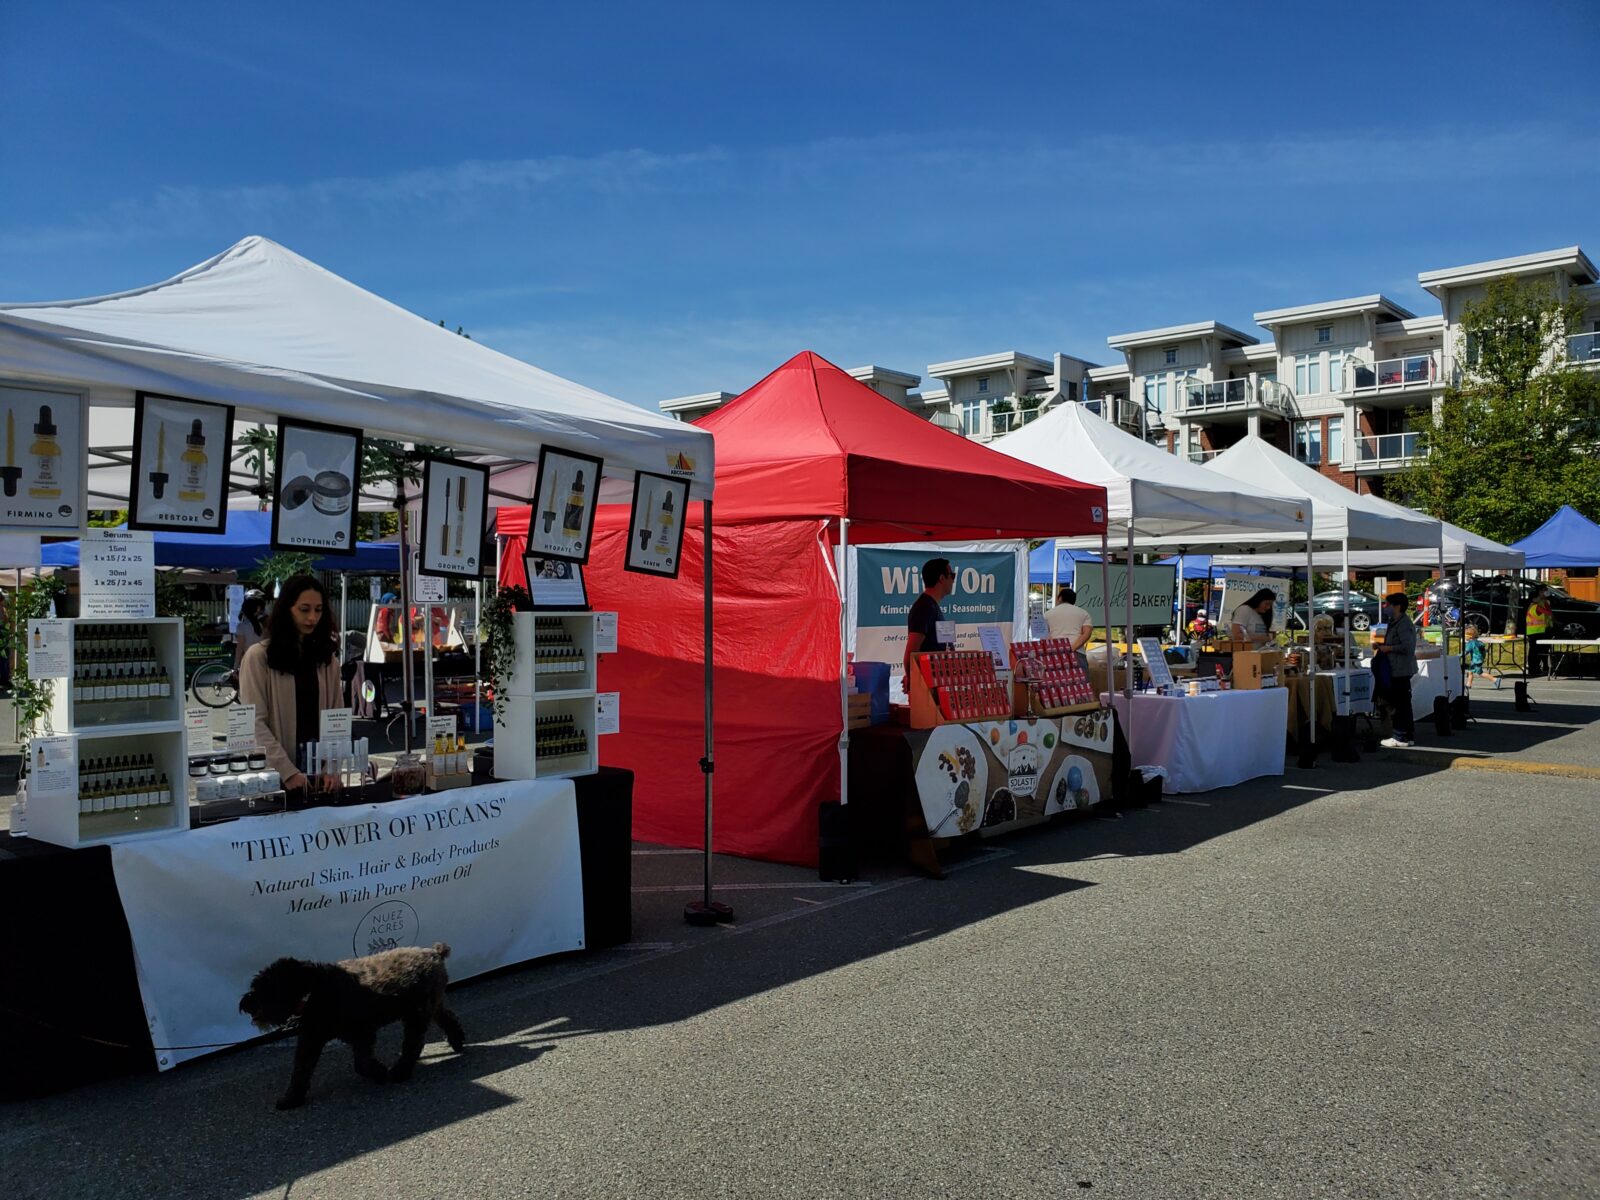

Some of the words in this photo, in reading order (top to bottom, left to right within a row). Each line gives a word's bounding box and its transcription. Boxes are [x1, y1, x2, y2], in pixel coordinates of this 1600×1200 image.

[7, 510, 53, 519] FIRMING
[158, 513, 200, 522] RESTORE
[103, 530, 133, 538] Serums
[290, 536, 338, 546] SOFTENING
[438, 562, 465, 571] GROWTH
[1132, 592, 1172, 608] BAKERY
[952, 603, 996, 614] Seasonings
[231, 836, 295, 862] "THE
[300, 821, 382, 854] POWER
[389, 814, 417, 838] OF
[423, 797, 507, 832] PECANS"
[250, 872, 316, 897] Natural
[319, 866, 354, 886] Skin,
[359, 856, 391, 877] Hair
[395, 854, 406, 870] &
[411, 848, 446, 867] Body
[448, 837, 500, 859] Products
[286, 895, 332, 916] Made
[338, 889, 371, 906] With
[374, 882, 407, 899] Pure
[410, 873, 450, 891] Pecan
[452, 863, 473, 880] Oil
[372, 909, 404, 924] NUEZ
[368, 921, 404, 936] ACRES
